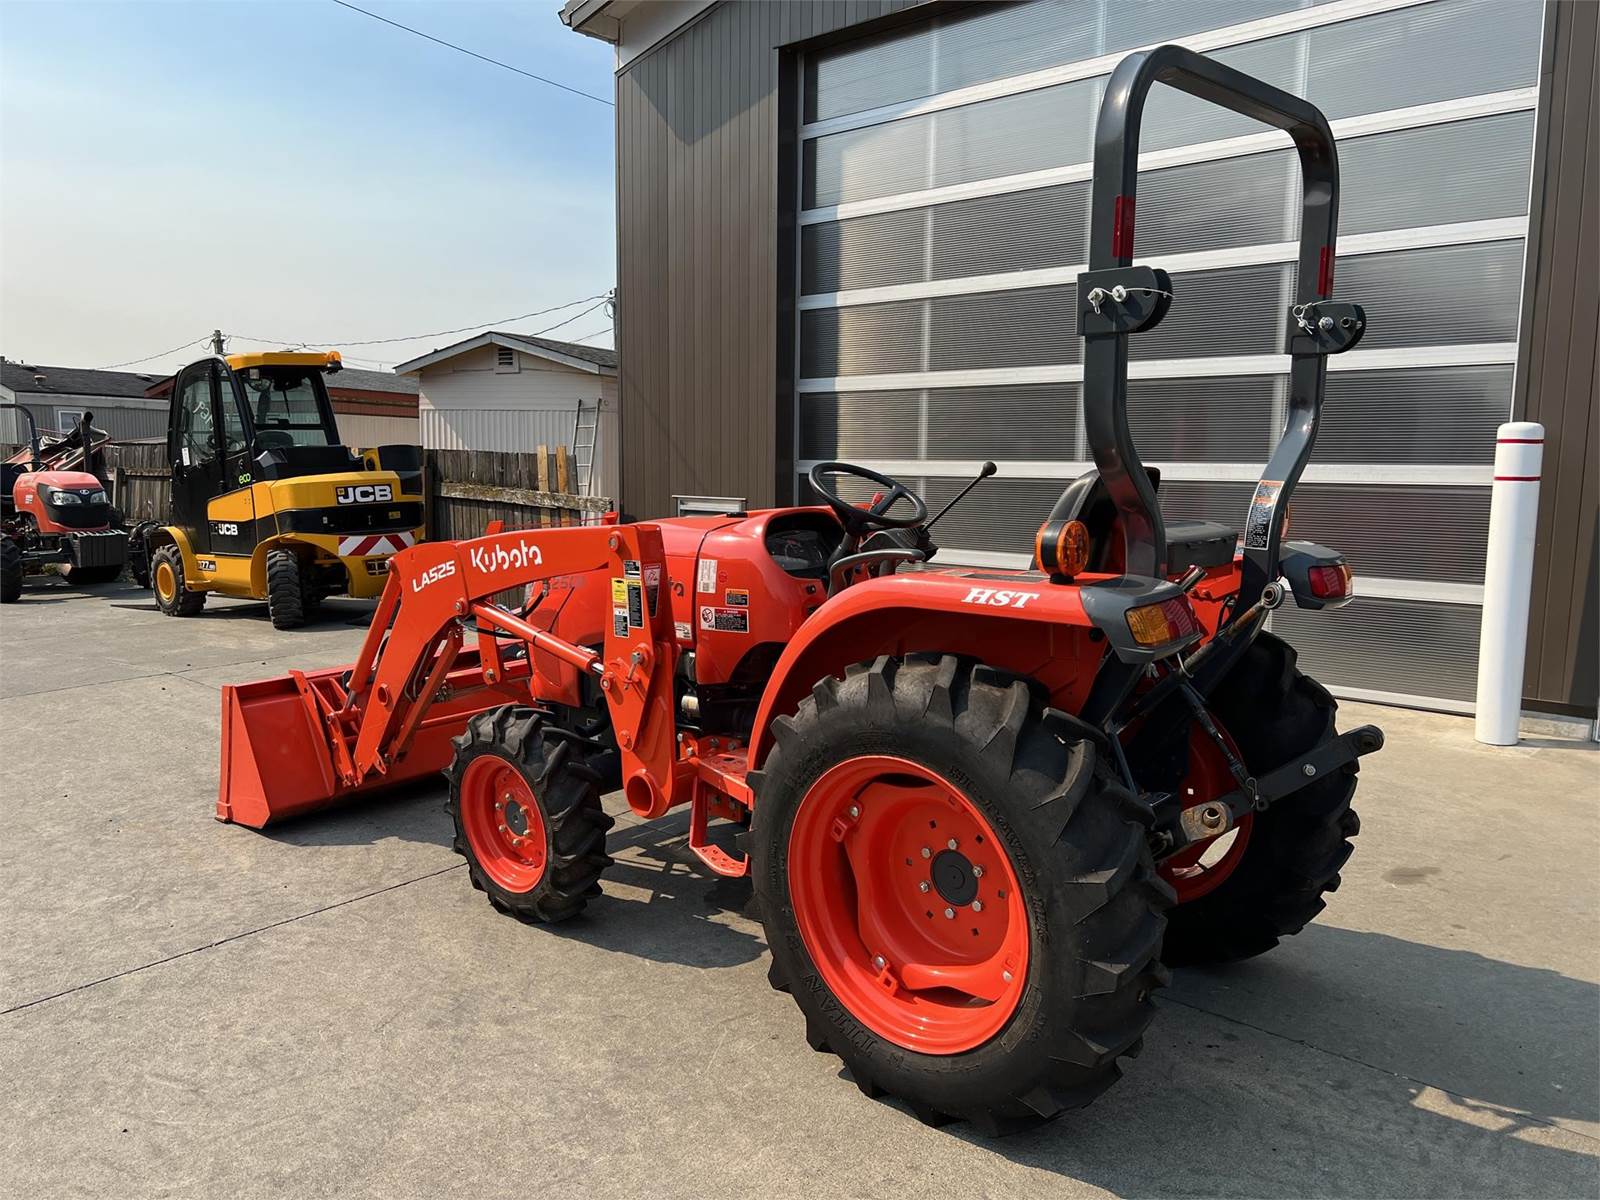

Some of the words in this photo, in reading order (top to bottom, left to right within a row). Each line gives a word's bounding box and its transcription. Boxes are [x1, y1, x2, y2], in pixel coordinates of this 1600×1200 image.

[238, 473, 252, 485] eco
[337, 485, 392, 504] JCB
[218, 523, 239, 536] JCB
[470, 539, 543, 574] Kubota
[412, 560, 456, 593] LA525
[961, 587, 1040, 609] HST
[803, 974, 878, 1058] TITAN
